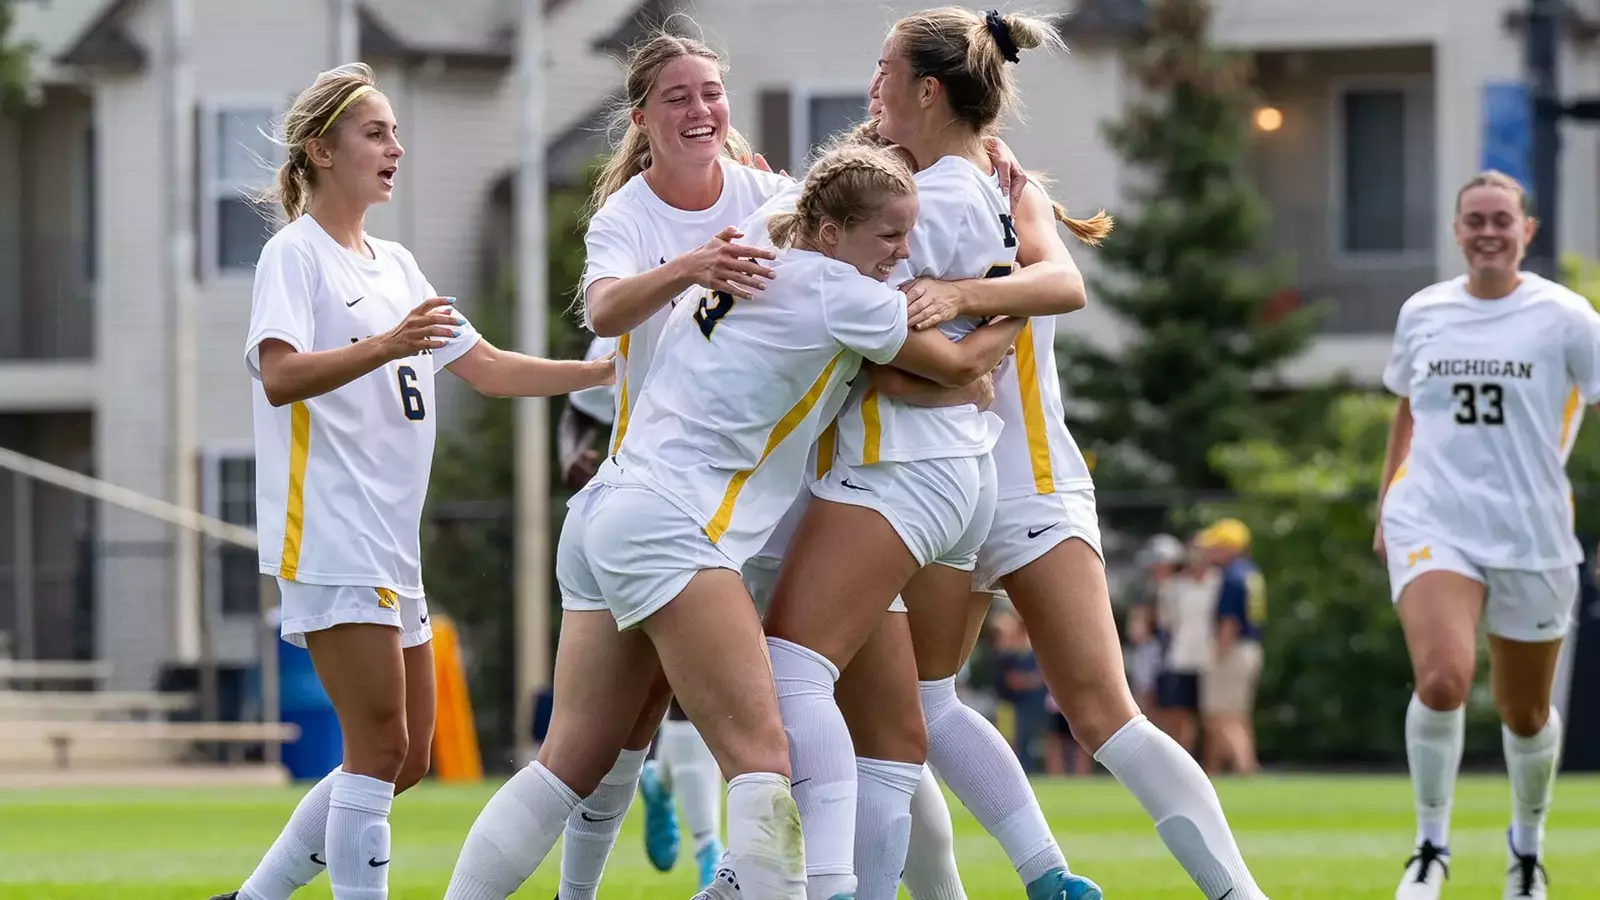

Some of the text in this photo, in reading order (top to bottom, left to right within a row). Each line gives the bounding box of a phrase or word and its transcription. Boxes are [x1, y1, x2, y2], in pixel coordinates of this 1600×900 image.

[1427, 359, 1533, 379] MICHIGAN
[396, 365, 426, 421] 6
[1451, 382, 1505, 426] 33
